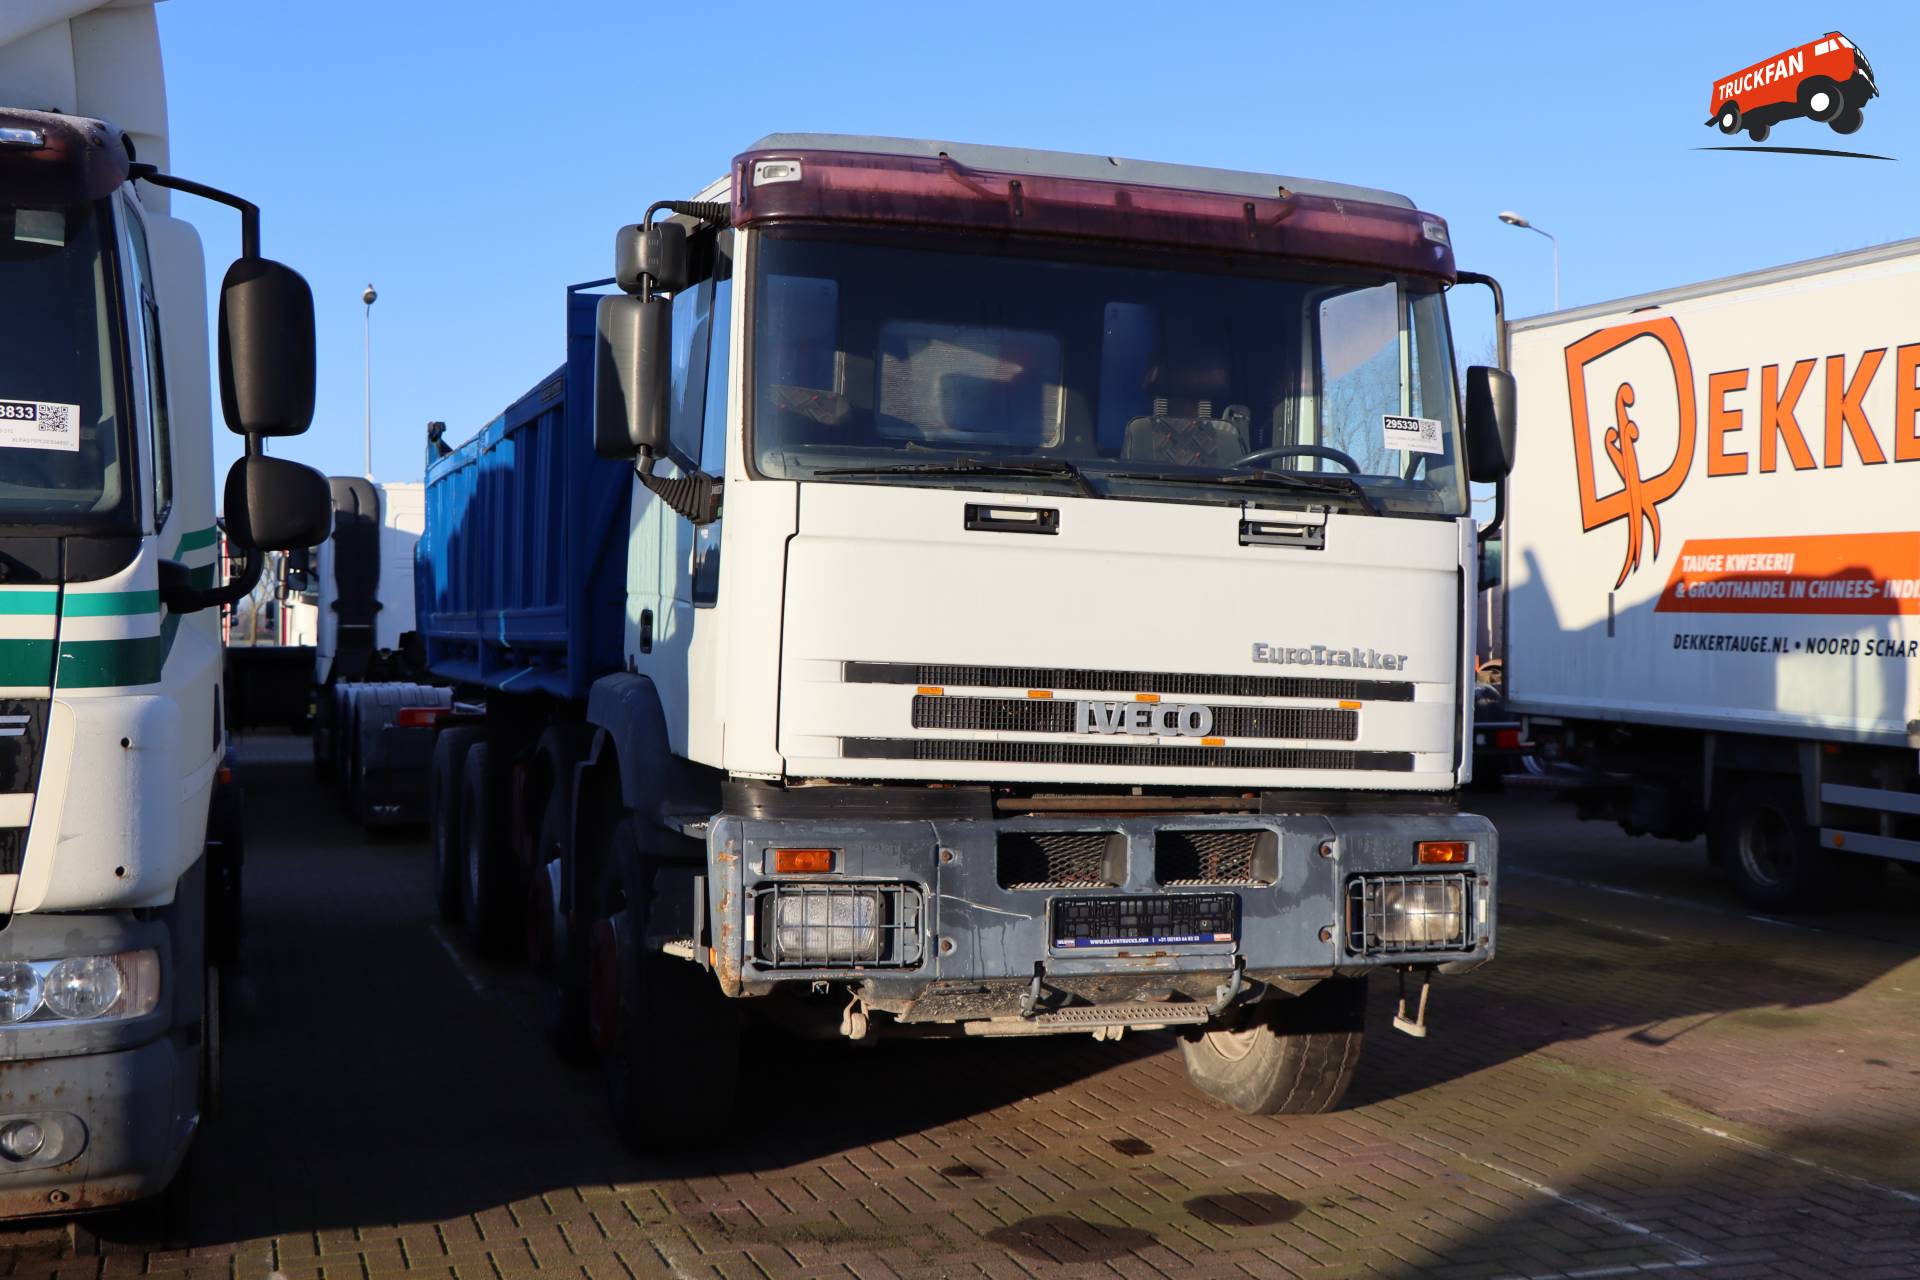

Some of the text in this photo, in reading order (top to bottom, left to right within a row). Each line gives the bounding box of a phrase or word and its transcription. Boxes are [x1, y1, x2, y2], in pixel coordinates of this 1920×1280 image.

[1385, 419, 1418, 431] 295330
[1682, 553, 1795, 574] TAUGE KWEKERIJ
[1675, 582, 1685, 598] &
[1688, 581, 1785, 598] GROOTHANDEL
[1788, 580, 1805, 598] IN
[1808, 580, 1880, 598] CHINEES-
[1252, 642, 1408, 671] EuroTrakker
[1673, 634, 1918, 657] DEKKERTAUGE.NL NOORD SCHAR
[1075, 700, 1213, 737] IVECO
